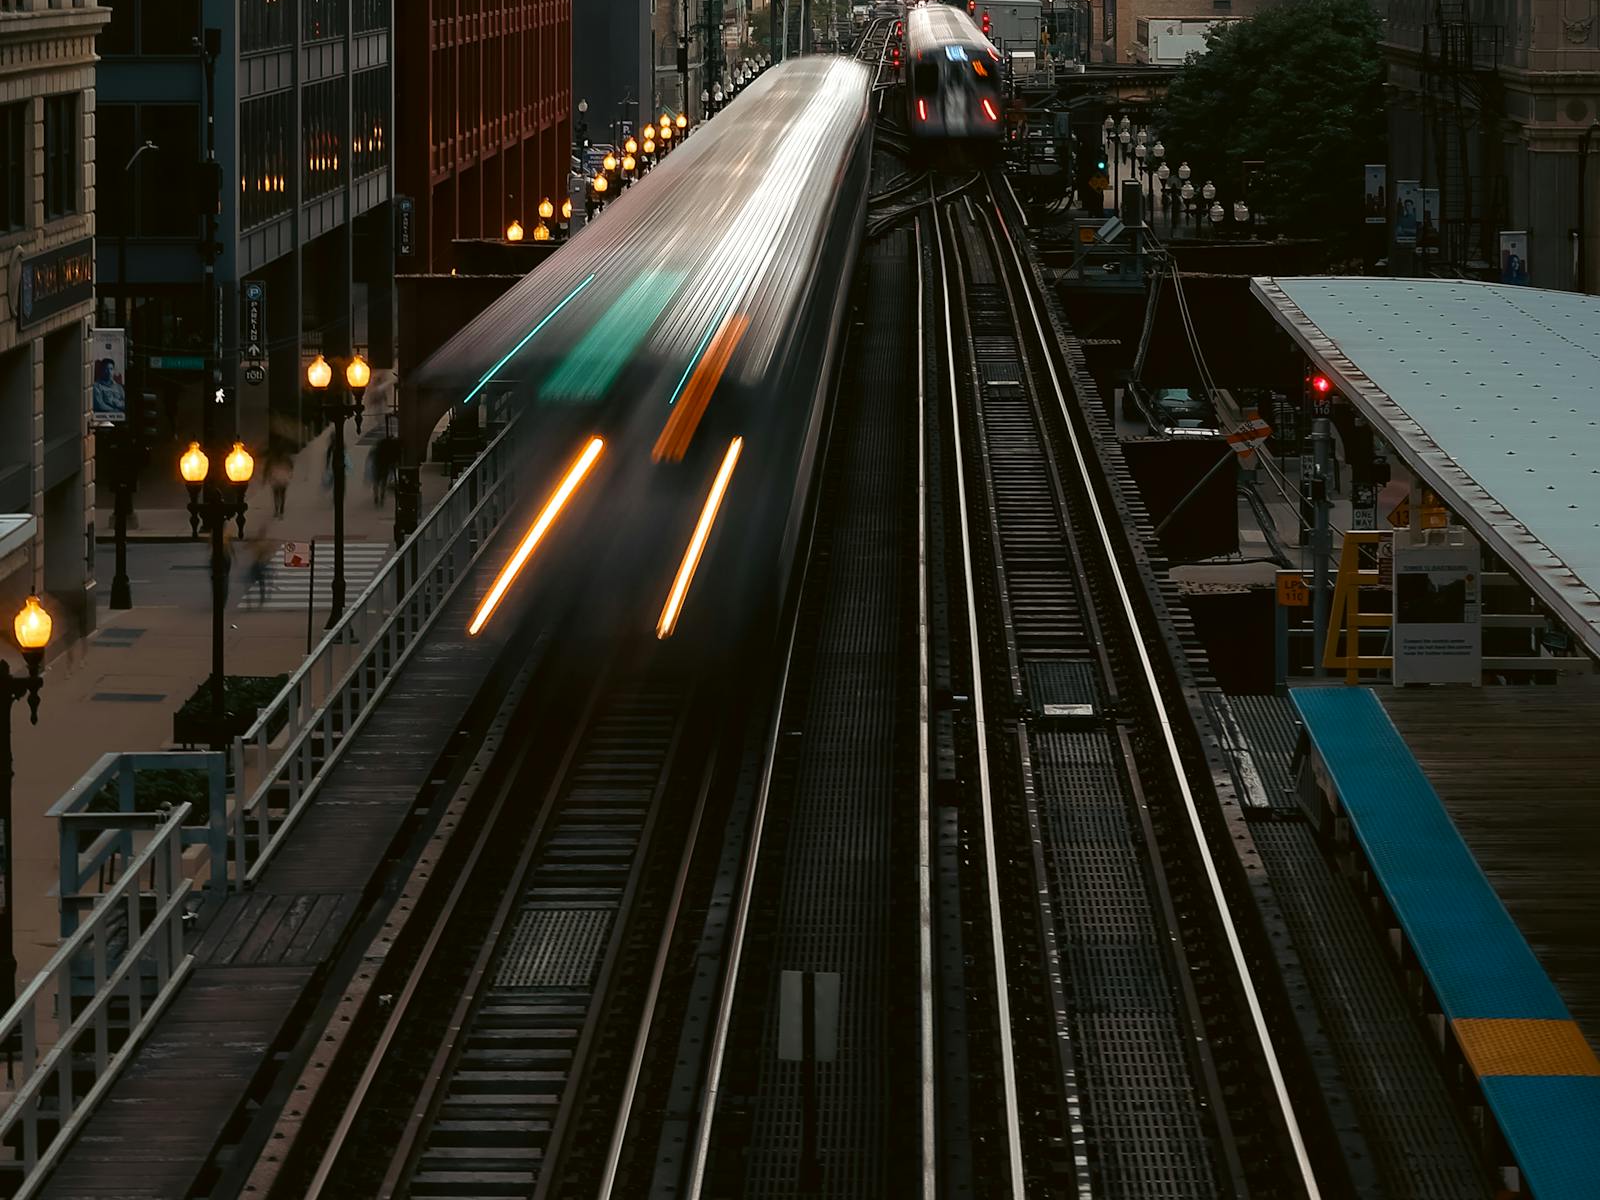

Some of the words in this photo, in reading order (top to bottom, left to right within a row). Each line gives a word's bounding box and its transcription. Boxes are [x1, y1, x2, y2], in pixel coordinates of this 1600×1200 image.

[250, 301, 258, 341] PARKING
[1314, 407, 1330, 416] 110
[1355, 511, 1373, 519] ONE
[1355, 519, 1373, 528] WAY
